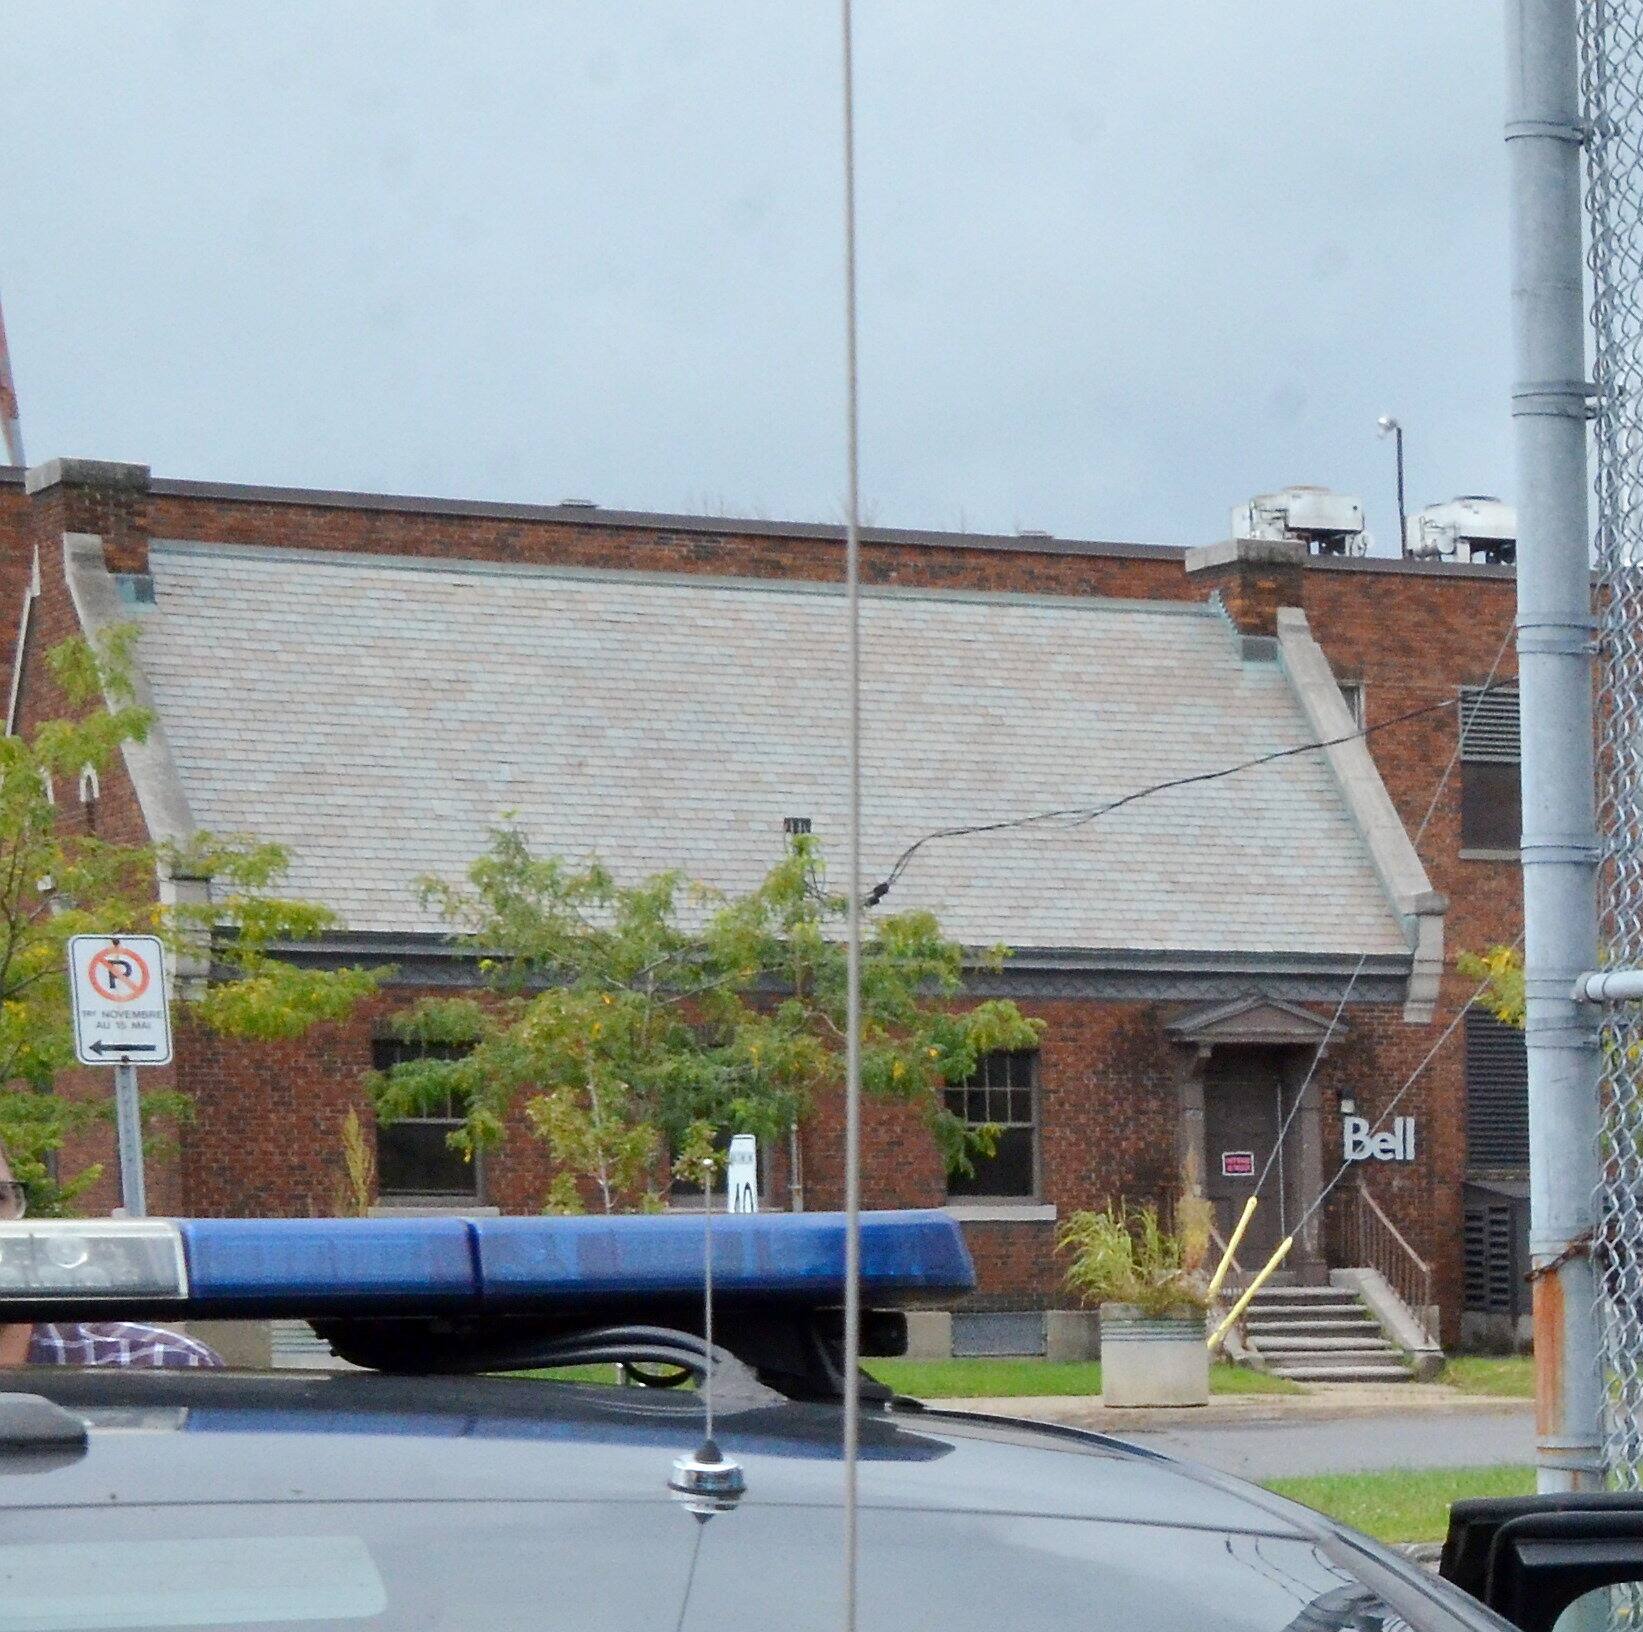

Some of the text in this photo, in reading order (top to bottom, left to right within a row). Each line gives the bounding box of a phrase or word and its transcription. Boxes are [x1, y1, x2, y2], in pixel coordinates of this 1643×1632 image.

[101, 1009, 164, 1019] NOVEMBRE
[96, 1020, 111, 1029] AU
[131, 1020, 151, 1029] MAI
[1344, 1116, 1415, 1160] Bell
